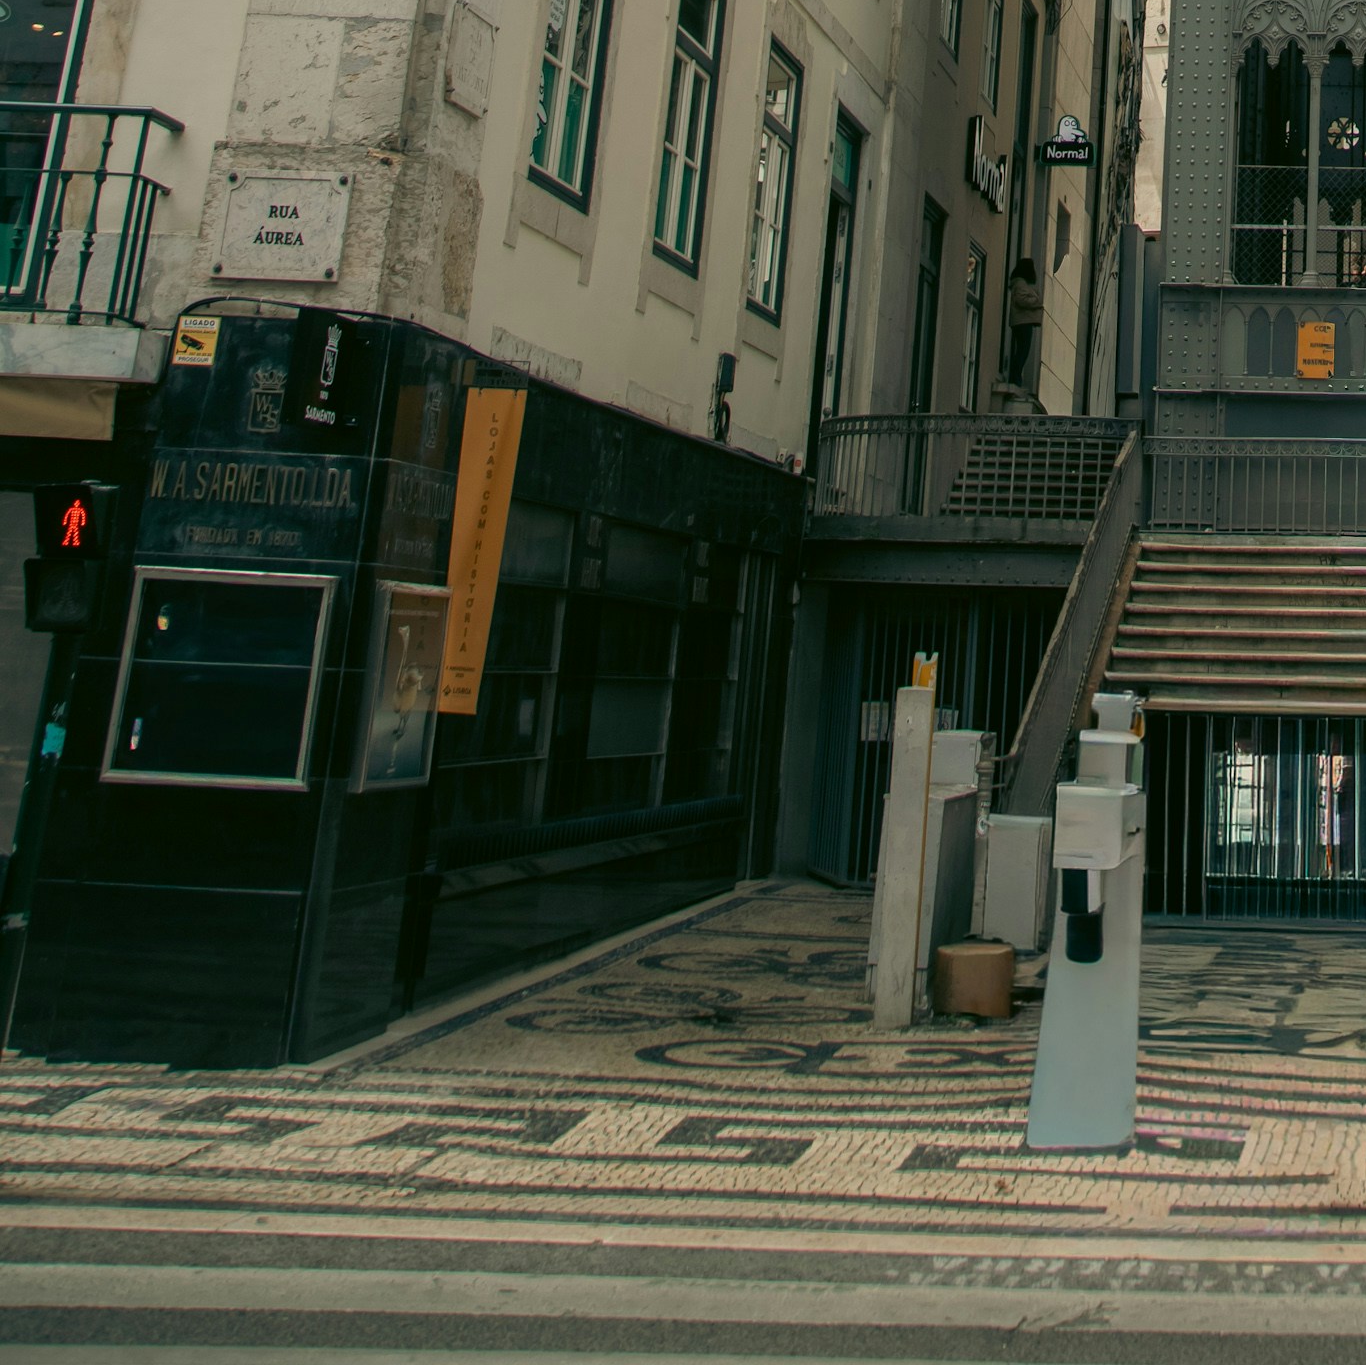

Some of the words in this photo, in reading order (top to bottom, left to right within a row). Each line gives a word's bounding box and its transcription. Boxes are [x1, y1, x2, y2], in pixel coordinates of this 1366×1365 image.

[1046, 144, 1088, 159] Normal
[268, 205, 300, 219] RUA
[253, 225, 305, 246] ÁUREA
[304, 405, 336, 425] SARMENTO
[477, 490, 490, 530] COM
